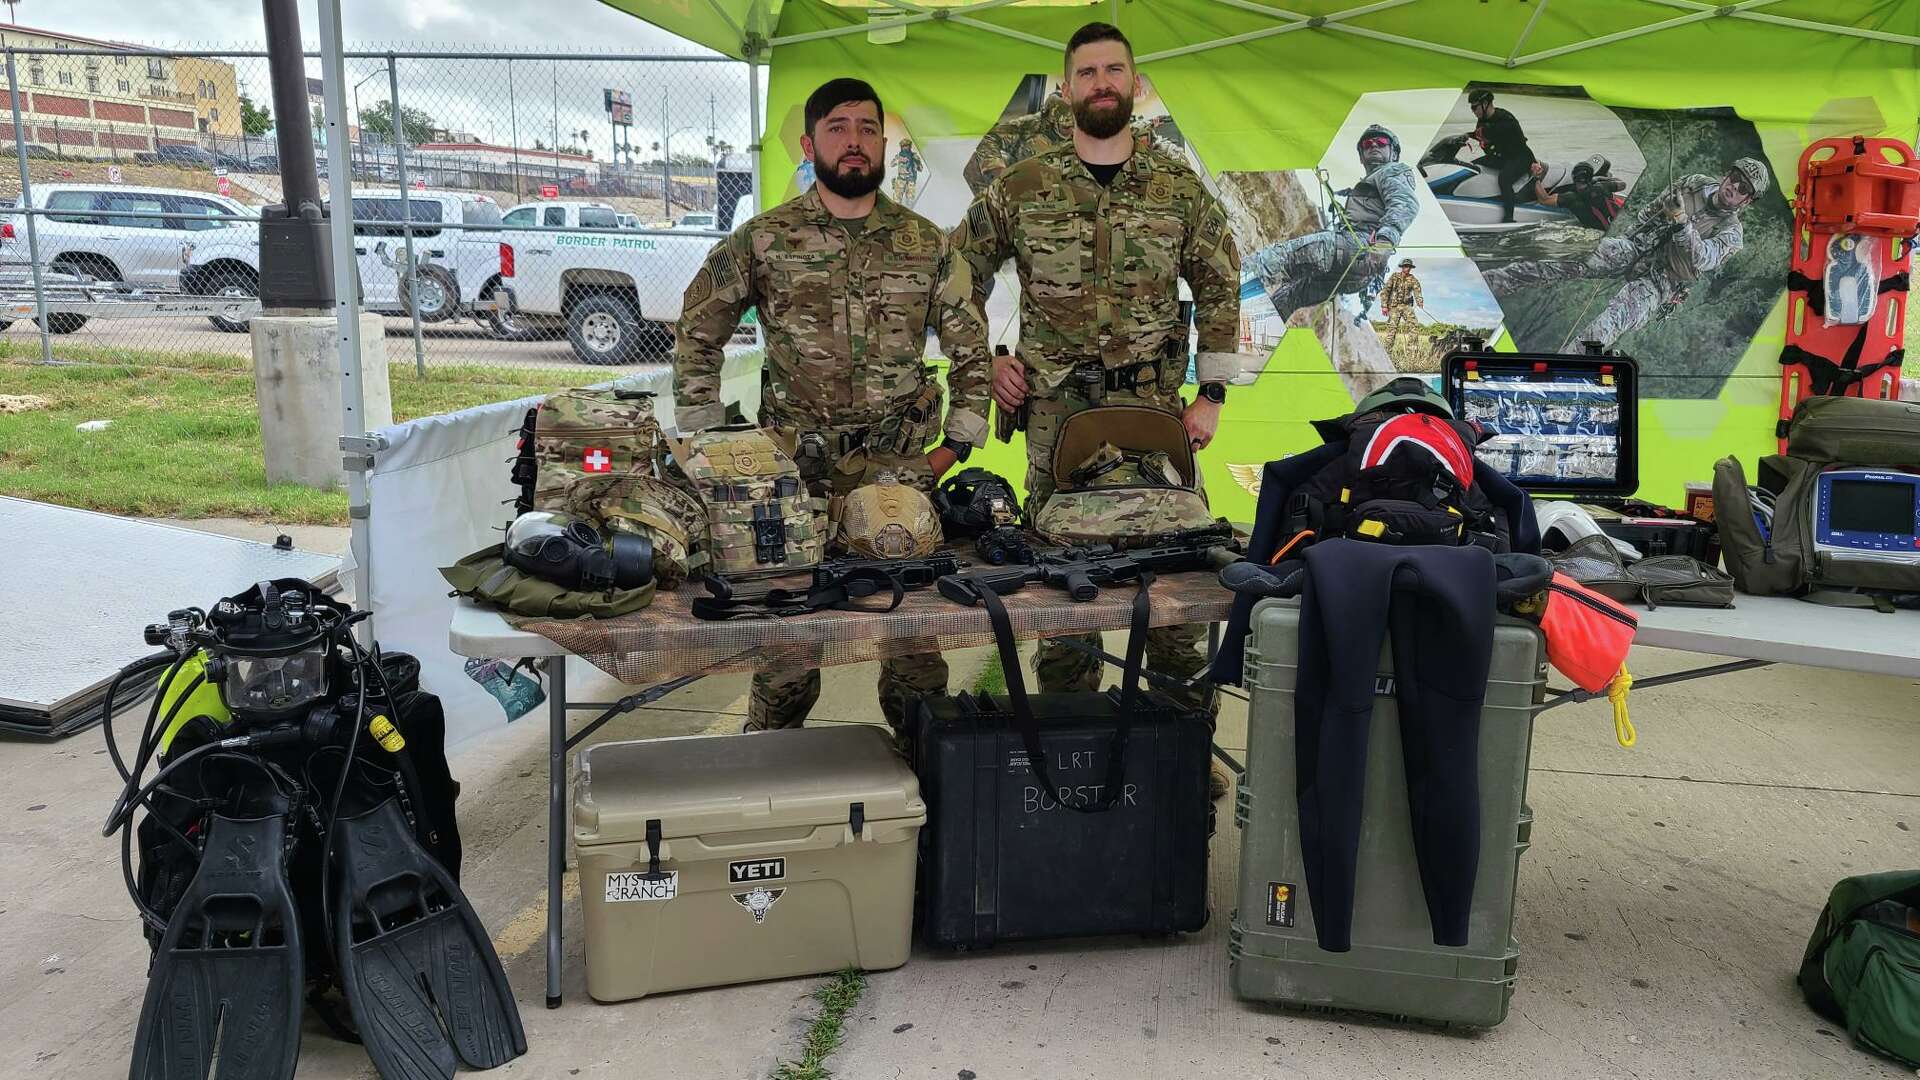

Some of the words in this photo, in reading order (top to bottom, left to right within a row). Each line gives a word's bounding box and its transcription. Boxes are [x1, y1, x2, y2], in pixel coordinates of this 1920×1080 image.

[556, 235, 606, 247] BORDER
[613, 238, 657, 250] PATROL
[1058, 751, 1097, 770] LRT
[1024, 783, 1137, 813] BORSTR
[732, 861, 781, 879] YETI
[621, 885, 676, 900] RANCH
